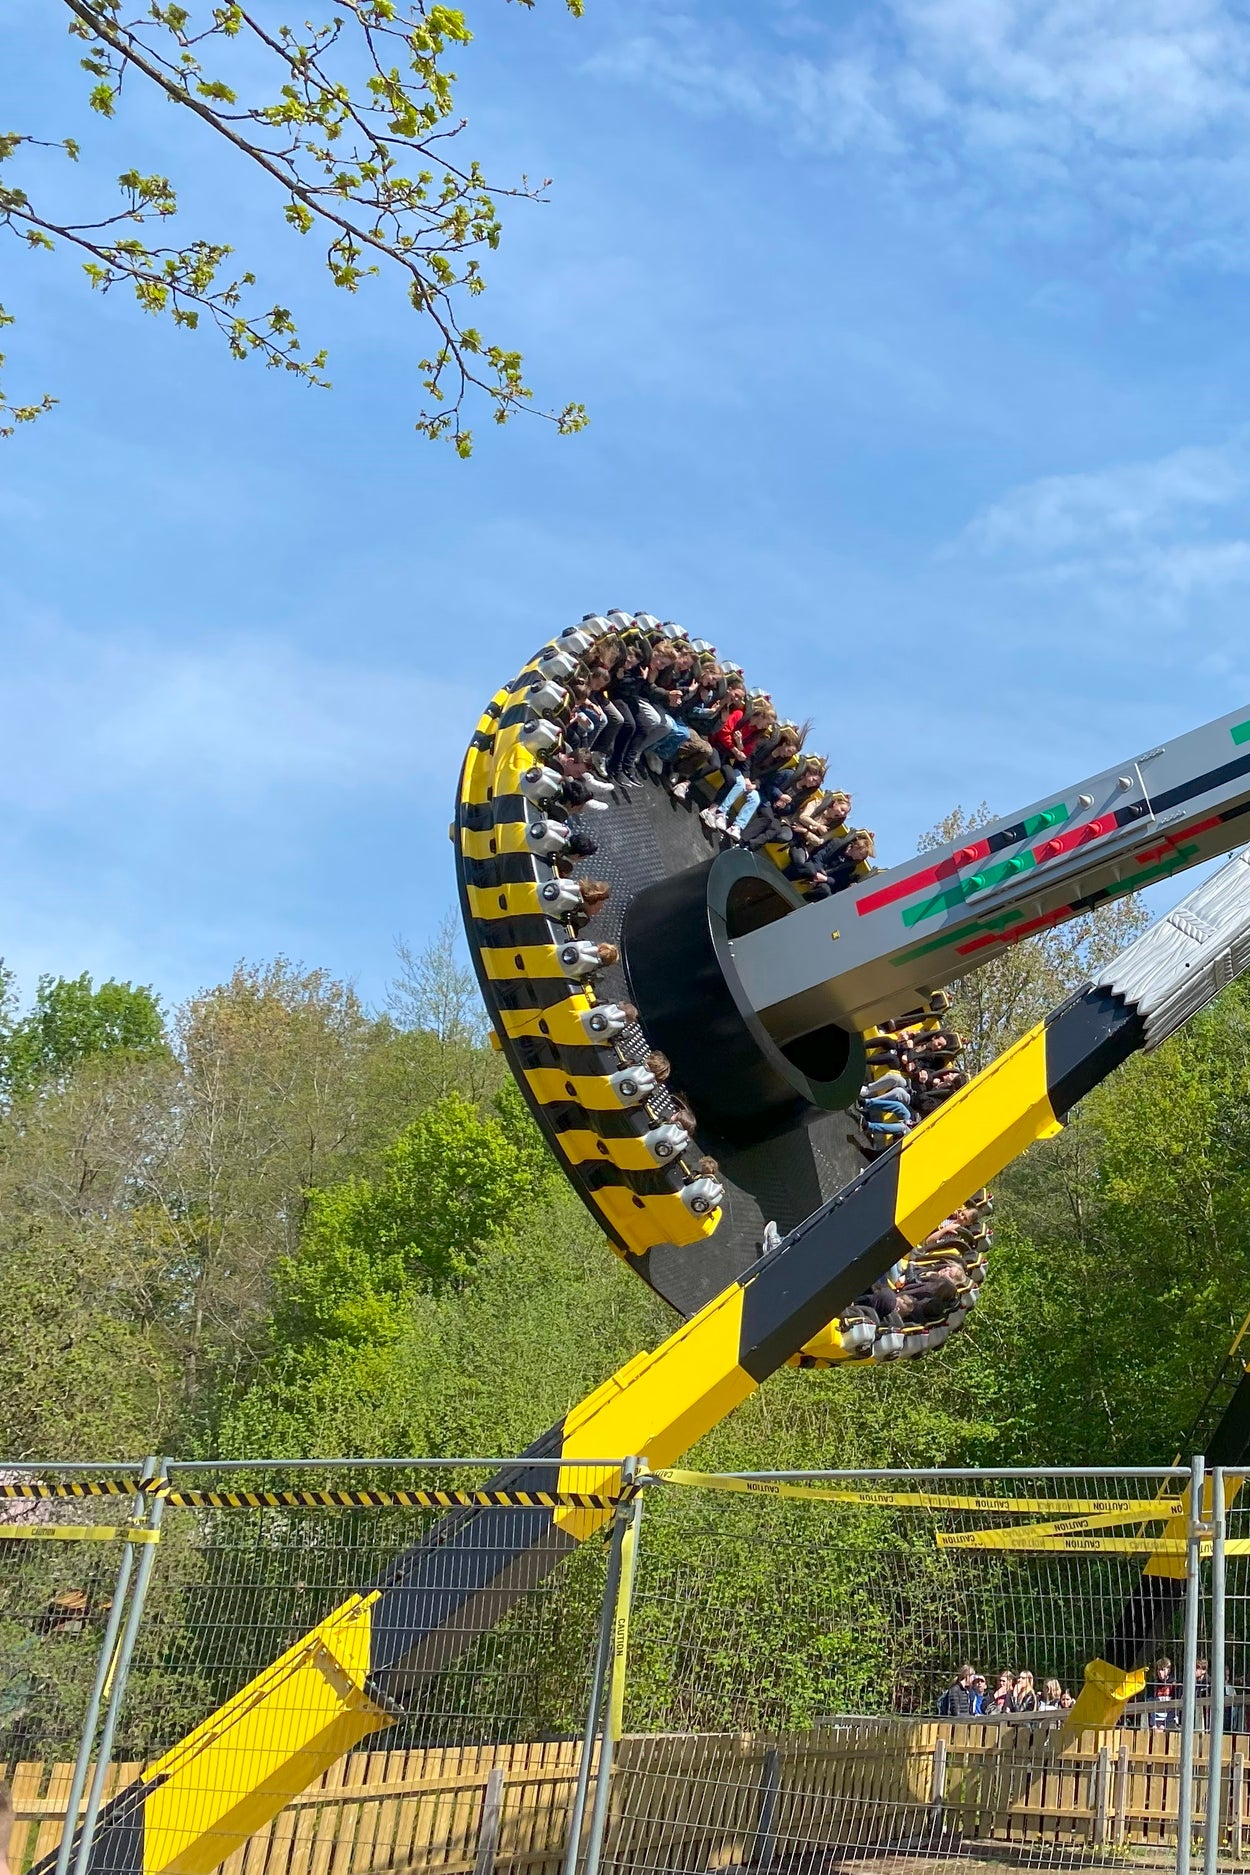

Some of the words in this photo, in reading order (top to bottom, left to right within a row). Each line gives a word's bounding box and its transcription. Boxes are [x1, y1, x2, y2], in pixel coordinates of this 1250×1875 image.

[746, 1482, 779, 1493] CAUTION
[860, 1494, 894, 1503] CAUTION
[975, 1499, 1010, 1509] CAUTION
[1093, 1502, 1129, 1511] CAUTION
[1053, 1519, 1089, 1532] CAUTION
[941, 1535, 976, 1545] CAUTION
[1065, 1541, 1100, 1551] CAUTION
[616, 1618, 625, 1657] CAUTION
